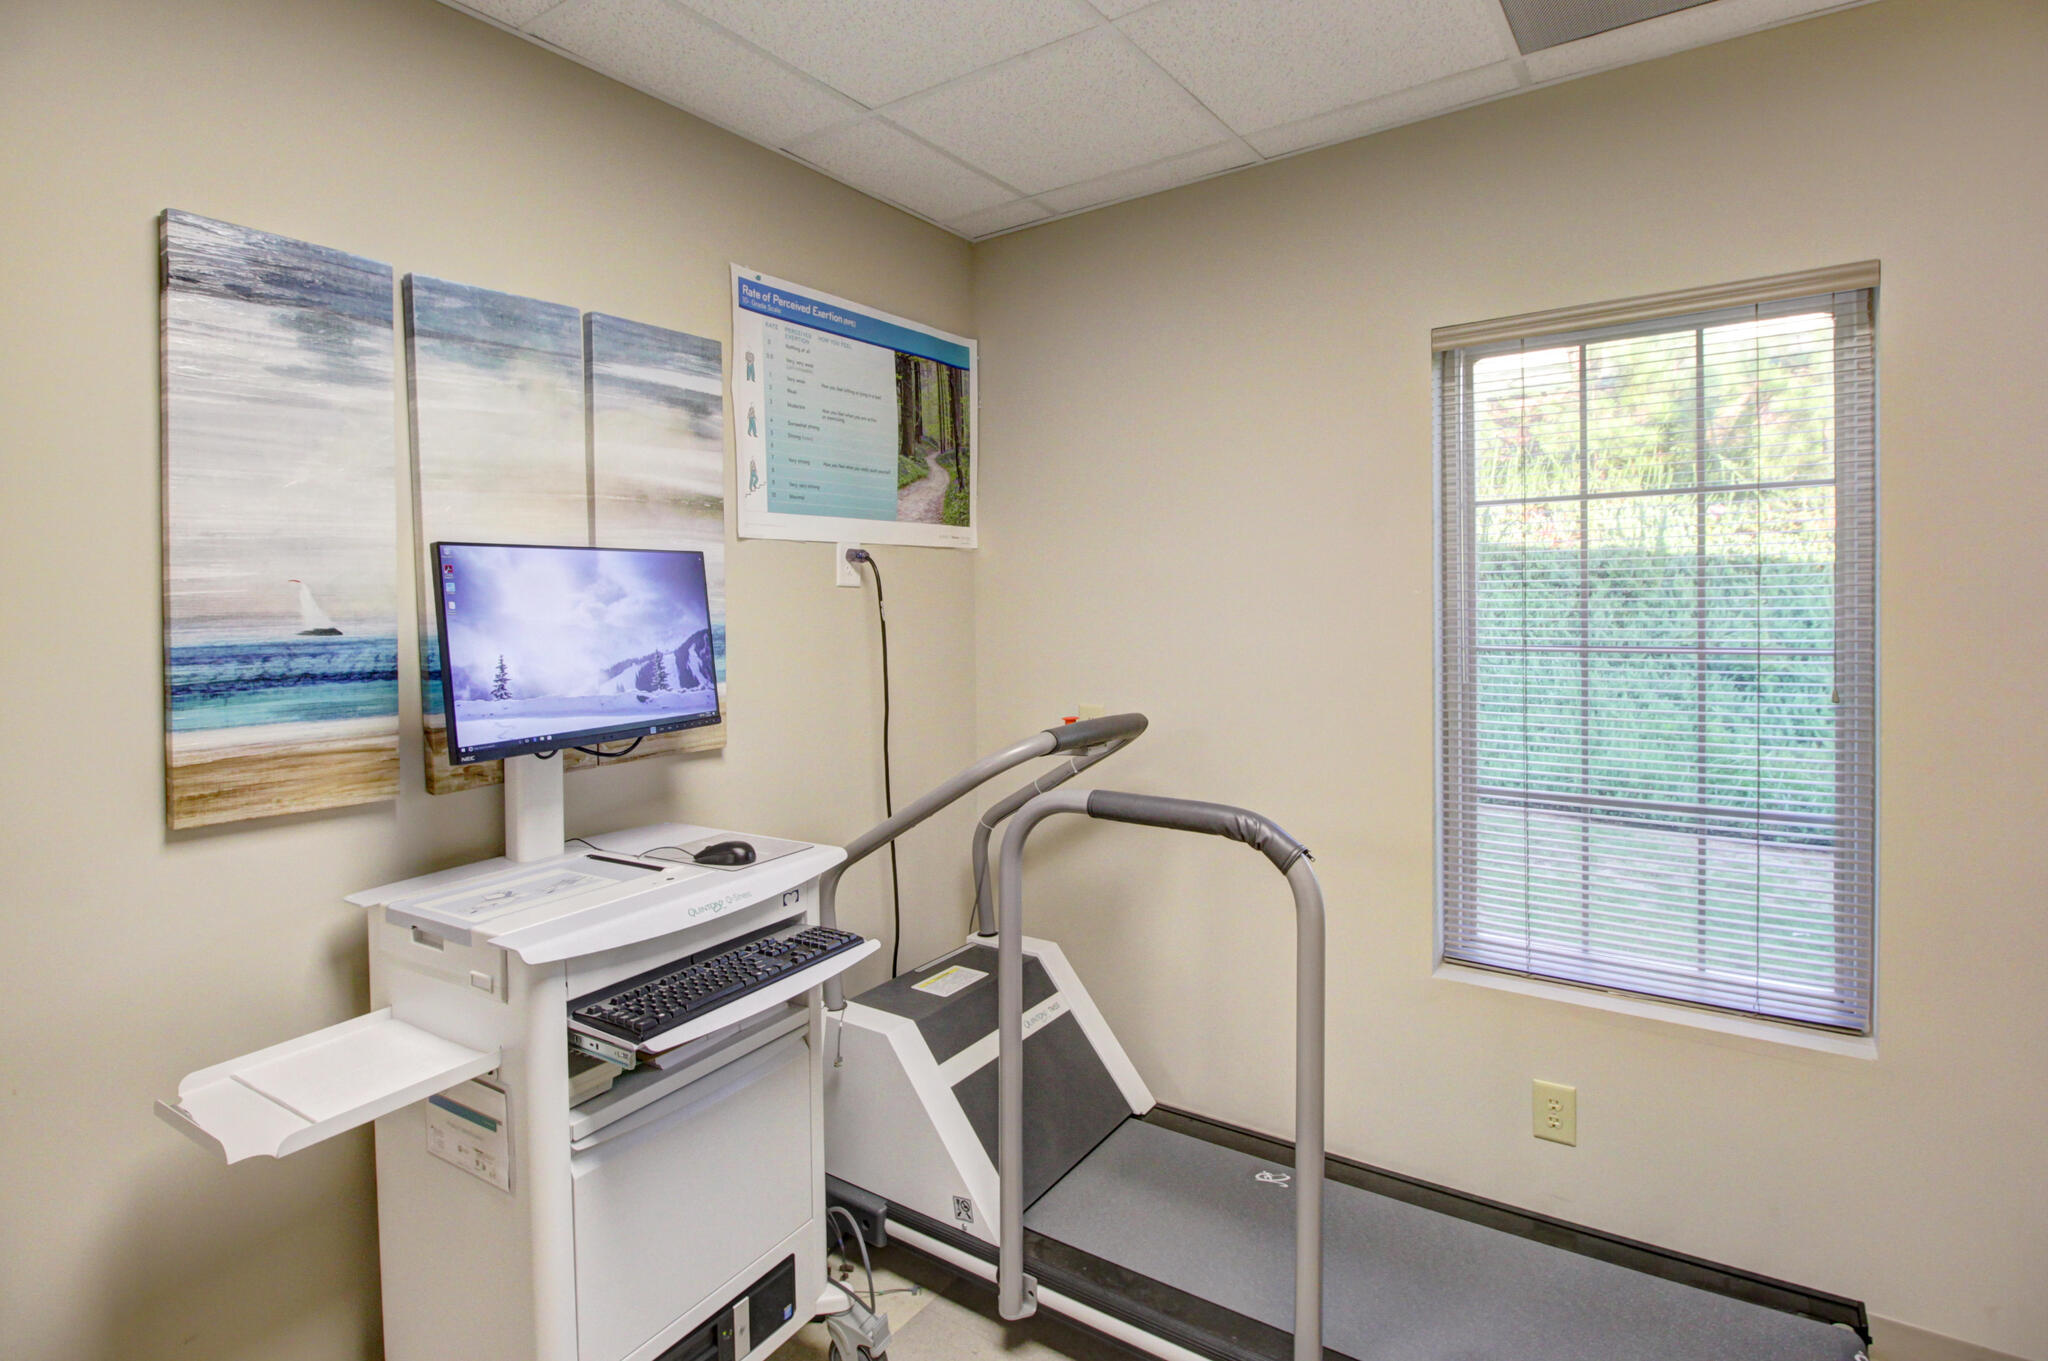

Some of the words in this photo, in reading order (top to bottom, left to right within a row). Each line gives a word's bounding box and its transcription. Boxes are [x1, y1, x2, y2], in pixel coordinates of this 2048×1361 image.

[742, 284, 760, 299] Rate
[762, 292, 771, 302] of
[773, 294, 811, 314] Perceived
[812, 306, 843, 324] Exertion
